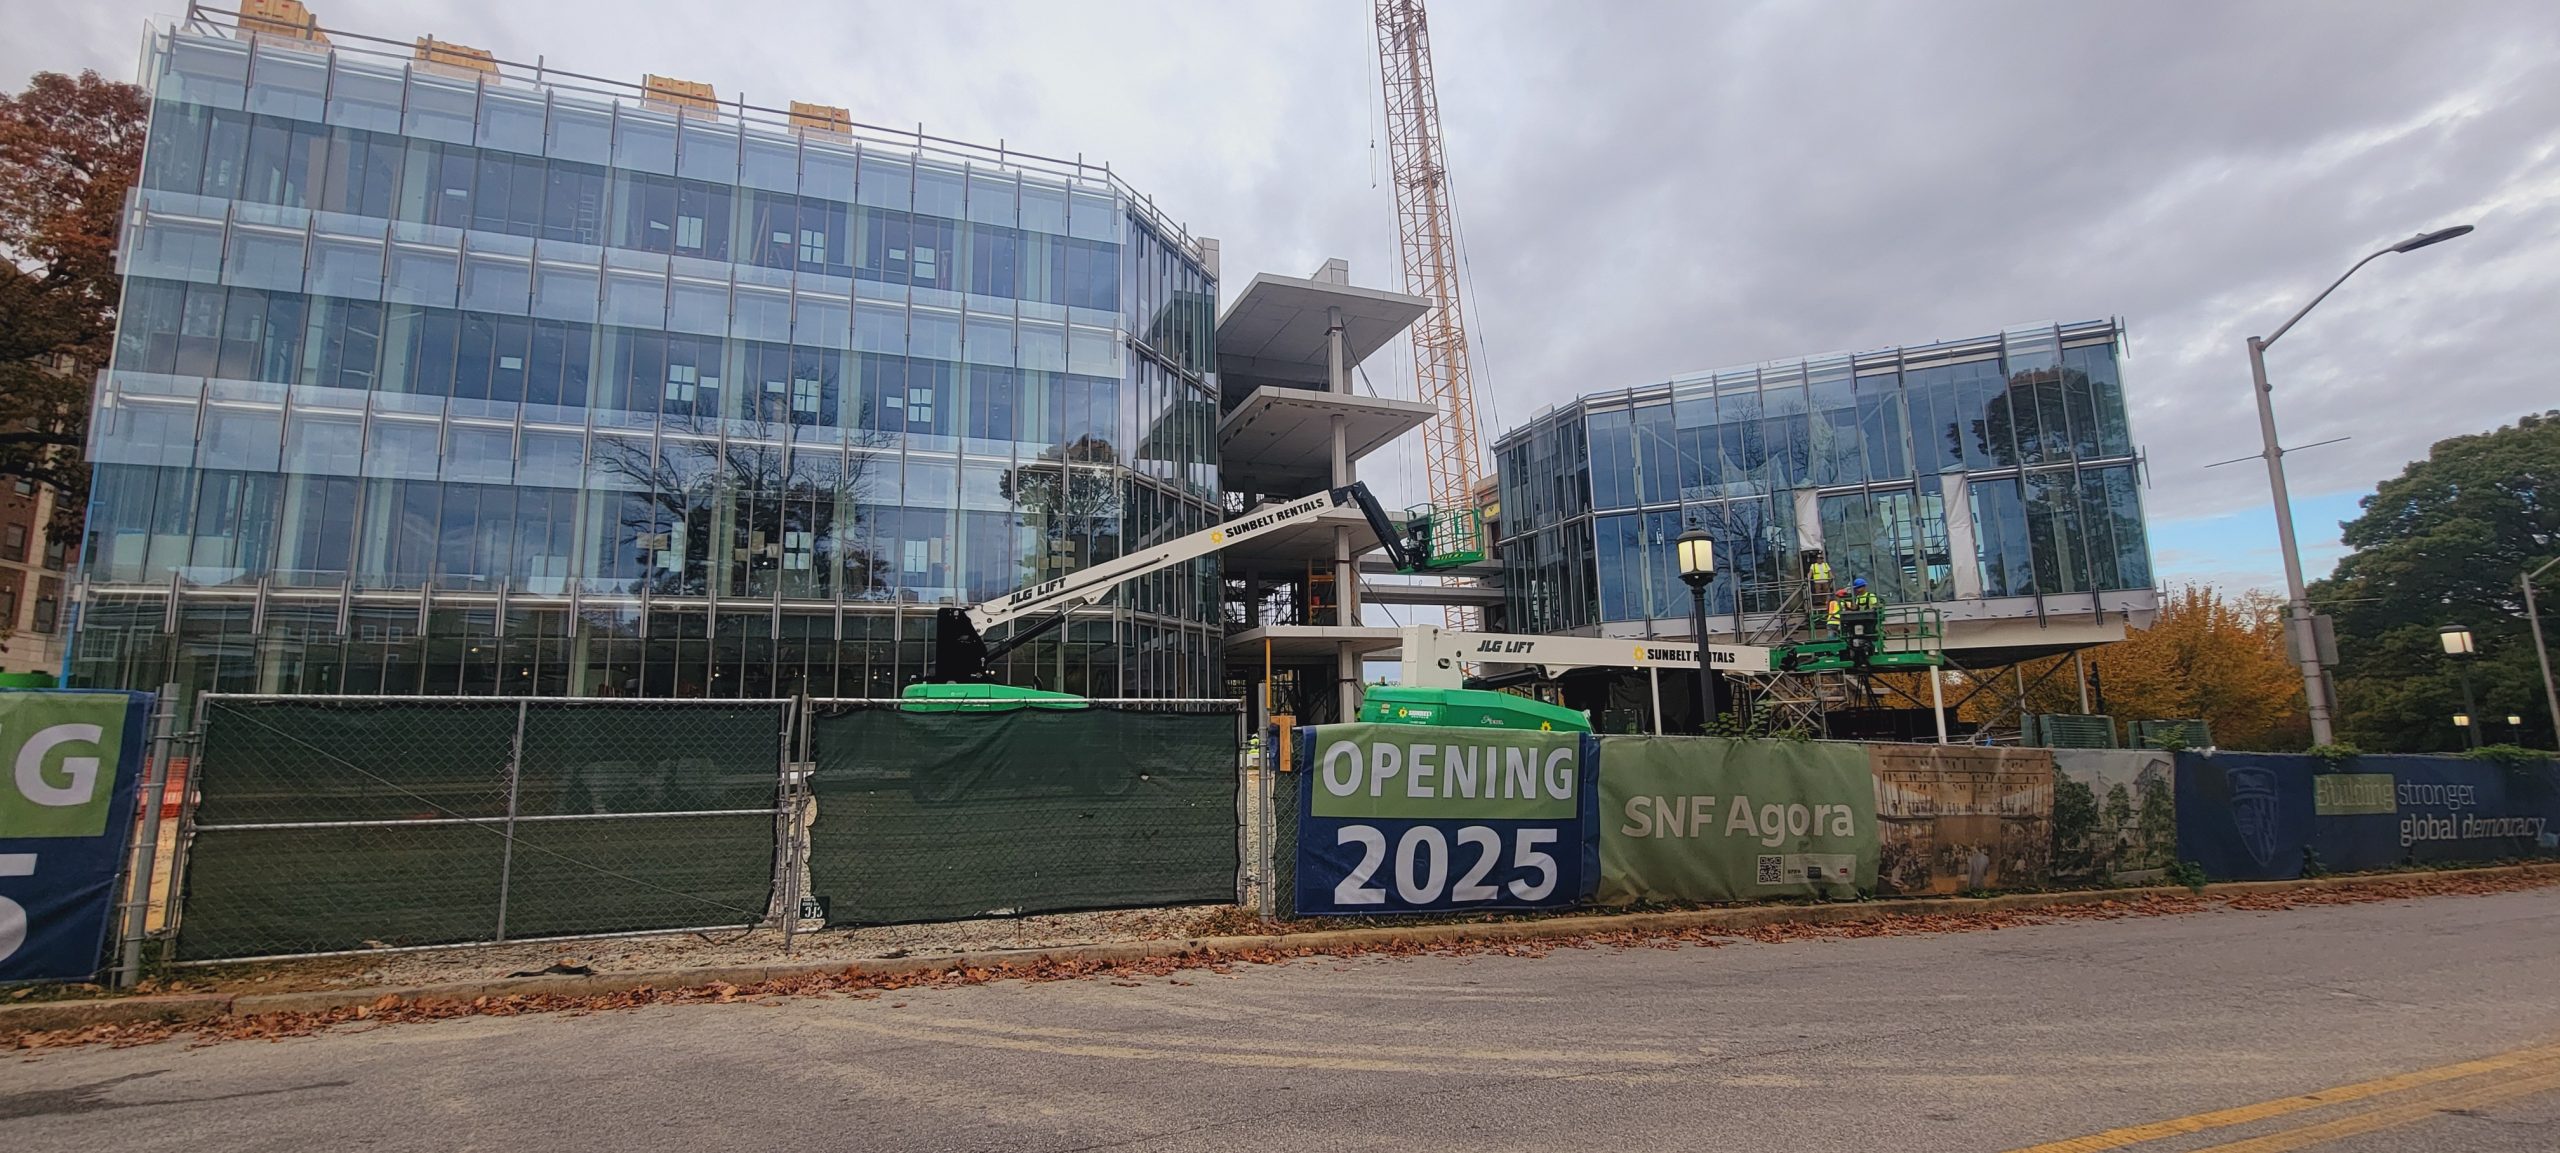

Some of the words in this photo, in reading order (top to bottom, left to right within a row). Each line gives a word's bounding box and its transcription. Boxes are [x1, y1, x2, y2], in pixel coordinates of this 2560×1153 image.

[1225, 513, 1275, 538] SUNBELT
[1277, 497, 1325, 520] RENTALS
[1007, 589, 1033, 606] JLG
[1037, 577, 1067, 597] LIFT
[1477, 640, 1502, 653] JLG
[1504, 641, 1535, 654] LIFT
[1647, 648, 1692, 662] SUNBELT
[1693, 651, 1735, 664] RTALS
[0, 723, 104, 806] G
[1322, 740, 1573, 800] OPENING
[2315, 776, 2396, 811] Building
[2398, 779, 2478, 810] stronger
[1621, 796, 1716, 839] SNF
[1724, 796, 1855, 847] Agora
[2400, 813, 2458, 847] global
[2461, 813, 2547, 842] democracy
[1334, 824, 1558, 905] 2025
